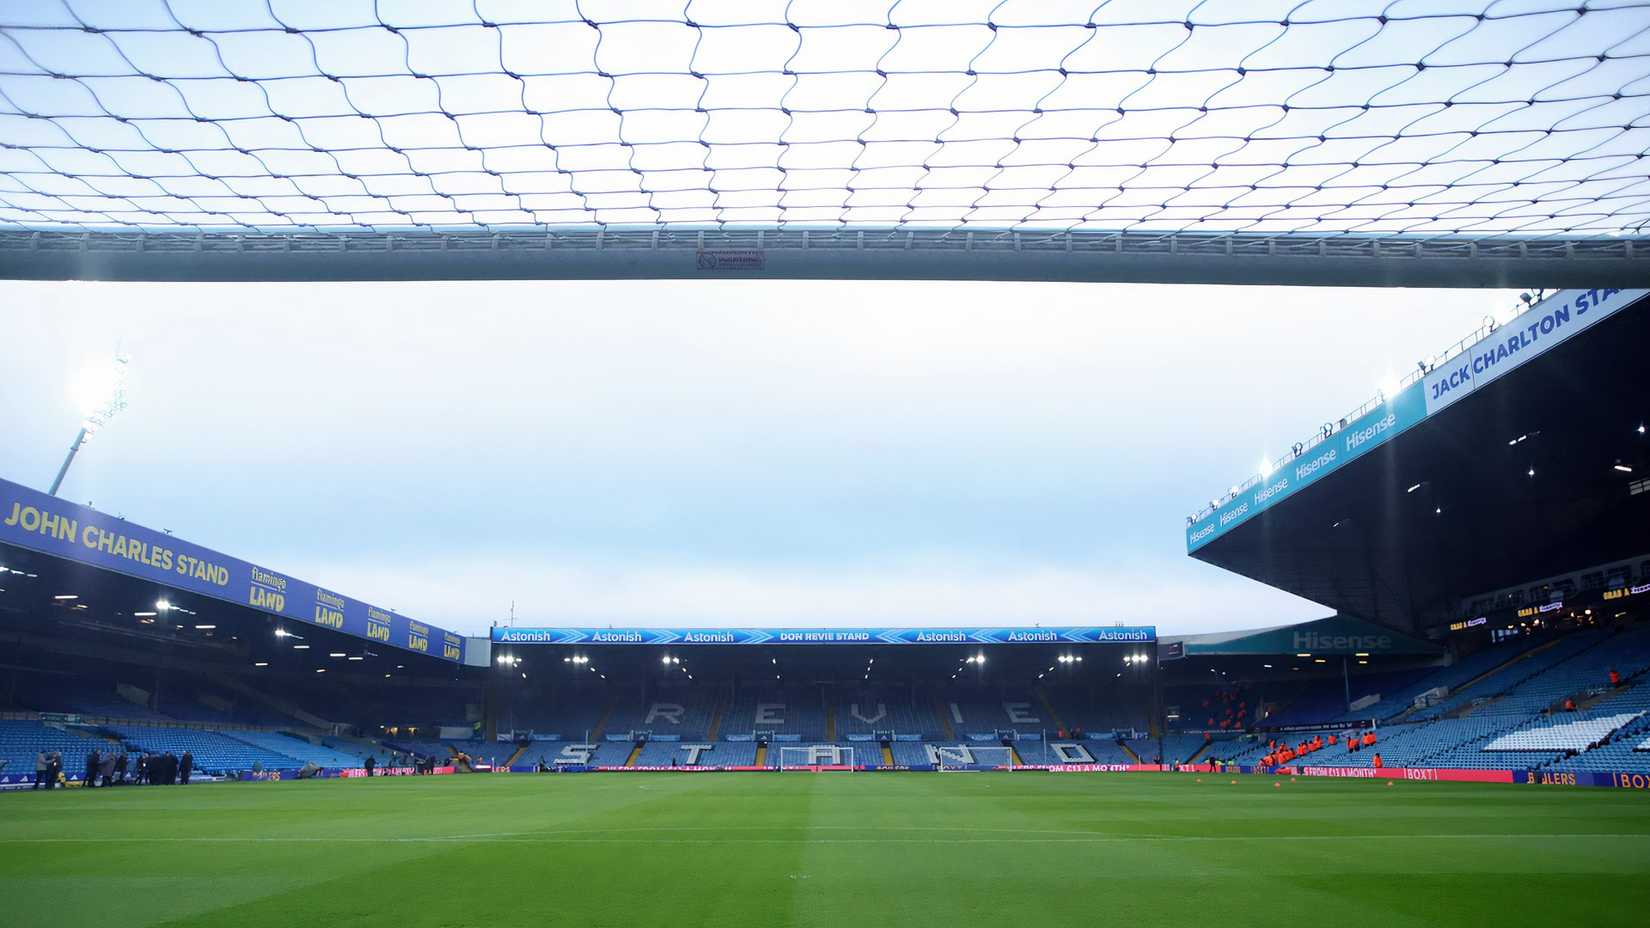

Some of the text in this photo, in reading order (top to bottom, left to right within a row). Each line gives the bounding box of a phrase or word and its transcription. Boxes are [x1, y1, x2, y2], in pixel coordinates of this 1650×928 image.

[1431, 288, 1624, 400] JACK CHARLTON STA
[1189, 413, 1396, 545] Hisense Hisense Hisense Hisense Hisense
[4, 502, 229, 586] JOHN CHARLES STAND
[251, 566, 287, 592] flamingo
[250, 586, 285, 612] LAND
[315, 606, 344, 629] LAND
[367, 622, 390, 641] LAND
[501, 631, 550, 642] Astonish
[592, 631, 642, 642] Astonish
[683, 631, 734, 643] Astonish
[780, 632, 801, 641] DON
[836, 632, 870, 641] STAND
[917, 631, 967, 642] Astonish
[1008, 630, 1058, 642] Astonish
[1099, 629, 1148, 641] Astonish
[408, 636, 428, 651] LAND
[1293, 631, 1392, 649] Hisense
[1527, 772, 1576, 786] BILERS
